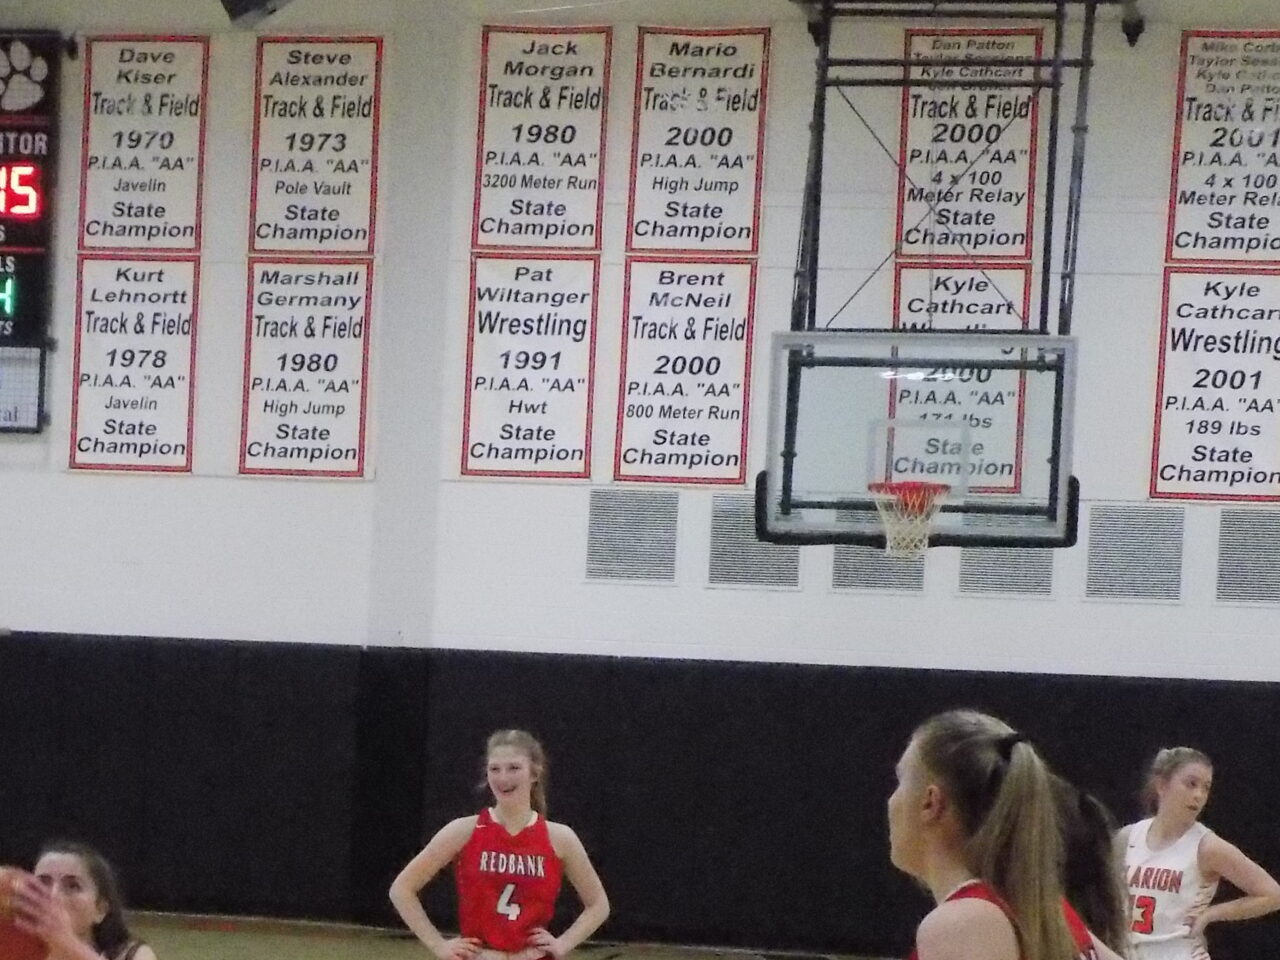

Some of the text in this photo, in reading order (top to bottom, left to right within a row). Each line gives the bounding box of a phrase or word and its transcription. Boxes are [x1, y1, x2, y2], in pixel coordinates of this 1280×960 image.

[523, 41, 577, 55] Jack
[669, 43, 737, 57] Mario
[932, 40, 1015, 50] Dan Patton
[119, 49, 175, 63] Dave
[287, 51, 351, 64] Steve
[1189, 55, 1236, 67] Taylor
[116, 70, 176, 84] Kiser
[504, 61, 593, 78] Morgan
[650, 64, 754, 78] Bernardi
[921, 68, 1022, 78] Kyle Cathcart
[269, 72, 368, 86] Alexander
[92, 92, 131, 116] Track
[159, 94, 200, 117] Field
[489, 85, 601, 110] Track & Field
[716, 88, 758, 112] Field
[263, 95, 371, 118] Track & Field
[911, 95, 1031, 119] Track & Field
[1186, 98, 1254, 122] Track &
[113, 132, 174, 150] 1970
[285, 133, 346, 151] 1973
[512, 125, 576, 144] 1980
[664, 128, 733, 146] 2000
[931, 124, 1001, 143] 2000
[1209, 128, 1280, 147] 2001
[88, 157, 194, 170] P.I.A.A. "AA"
[260, 159, 369, 173] P.I.A.A. "AA"
[485, 152, 597, 167] P.I.A.A. "AA"
[641, 154, 754, 169] P.I.A.A. "AA"
[113, 179, 166, 192] Javelin
[482, 175, 597, 190] 3200 Meter Run
[652, 177, 738, 194] High Jump
[931, 171, 1002, 185] 4 x 100
[1204, 174, 1277, 188] 4 x 100
[275, 181, 351, 195] Pole Vault
[907, 189, 1025, 205] Meter Relay
[1179, 191, 1236, 205] Meter
[112, 202, 165, 218] State
[285, 205, 339, 221] State
[510, 200, 566, 217] State
[665, 202, 723, 218] State
[936, 209, 995, 225] State
[480, 219, 594, 237] Champion
[1207, 212, 1269, 229] State
[86, 221, 194, 238] Champion
[256, 223, 367, 241] Champion
[634, 221, 751, 239] Champion
[905, 229, 1026, 248] Champion
[115, 268, 164, 282] Kurt
[260, 271, 359, 286] Marshall
[515, 268, 552, 282] Pat
[658, 271, 725, 286] Brent
[934, 277, 989, 295] Kyle
[1204, 281, 1260, 300] Kyle
[91, 289, 186, 304] Lehnortt
[257, 292, 361, 310] Germany
[477, 287, 590, 307] Wiltanger
[649, 293, 731, 308] McNeil
[908, 299, 1013, 314] Cathcart
[85, 311, 192, 335] Track & Field
[255, 315, 363, 338] Track & Field
[478, 311, 586, 342] Wrestling
[632, 316, 746, 341] Track & Field
[106, 350, 167, 368] 1978
[276, 354, 338, 371] 1980
[499, 352, 560, 370] 1991
[653, 356, 720, 375] 2000
[1193, 369, 1262, 390] 2001
[105, 396, 157, 410] Javelin
[263, 400, 345, 417] High Jump
[508, 400, 547, 414] Hwt
[626, 405, 740, 420] 800 Meter Run
[103, 419, 157, 435] State
[276, 425, 330, 441] State
[499, 425, 555, 441] State
[1186, 420, 1261, 436] 189 lbs
[653, 430, 710, 446] State
[77, 438, 185, 457] Champion
[247, 443, 356, 461] Champion
[470, 443, 583, 462] Champion
[1192, 445, 1252, 463] State
[623, 449, 739, 468] Champion
[480, 851, 545, 877] REDBANK
[497, 884, 520, 920] 4
